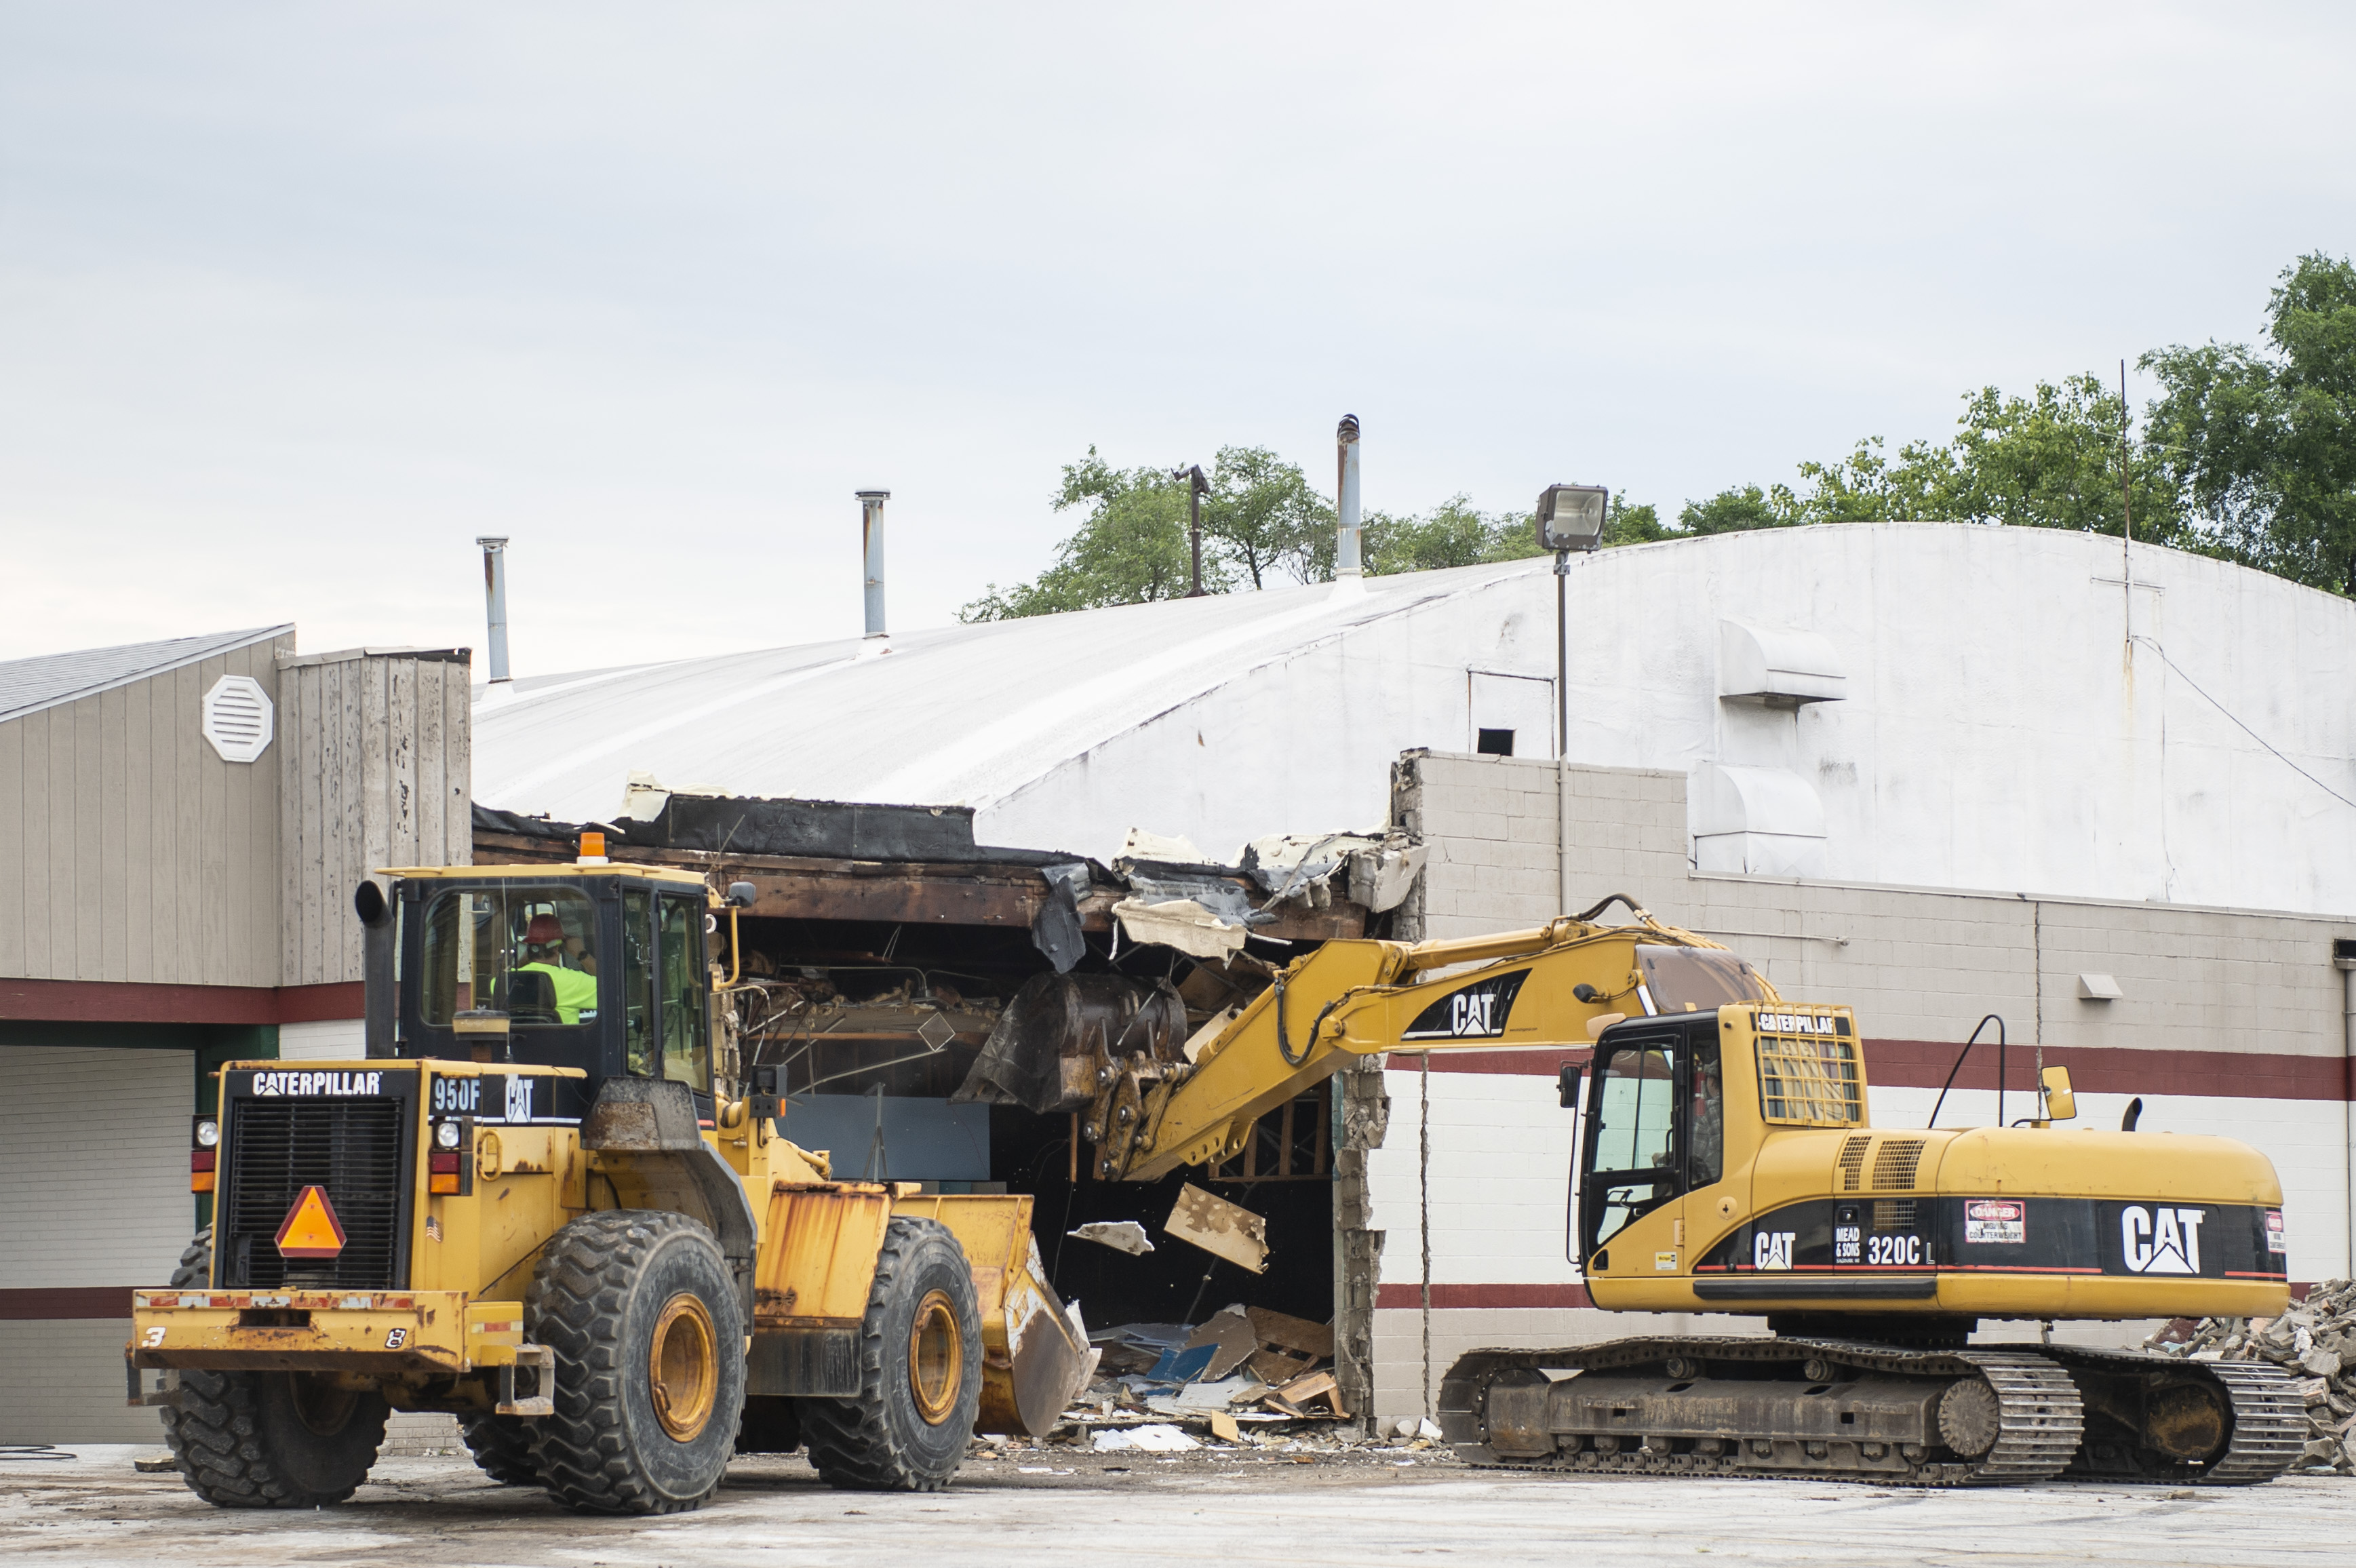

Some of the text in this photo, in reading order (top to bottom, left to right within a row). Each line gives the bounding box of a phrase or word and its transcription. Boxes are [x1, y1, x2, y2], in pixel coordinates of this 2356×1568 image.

[1453, 994, 1495, 1036] CAT
[253, 1072, 380, 1095] CATERPILLAR
[435, 1078, 480, 1110] 950F
[505, 1079, 534, 1123] CAT
[1974, 1207, 2015, 1217] DANGER
[1836, 1228, 1860, 1242] MEAD
[1836, 1242, 1860, 1257] & SONS
[2121, 1206, 2203, 1274] CAT
[1755, 1232, 1796, 1270] CAT
[1868, 1236, 1920, 1265] 320C
[385, 1328, 406, 1349] 8
